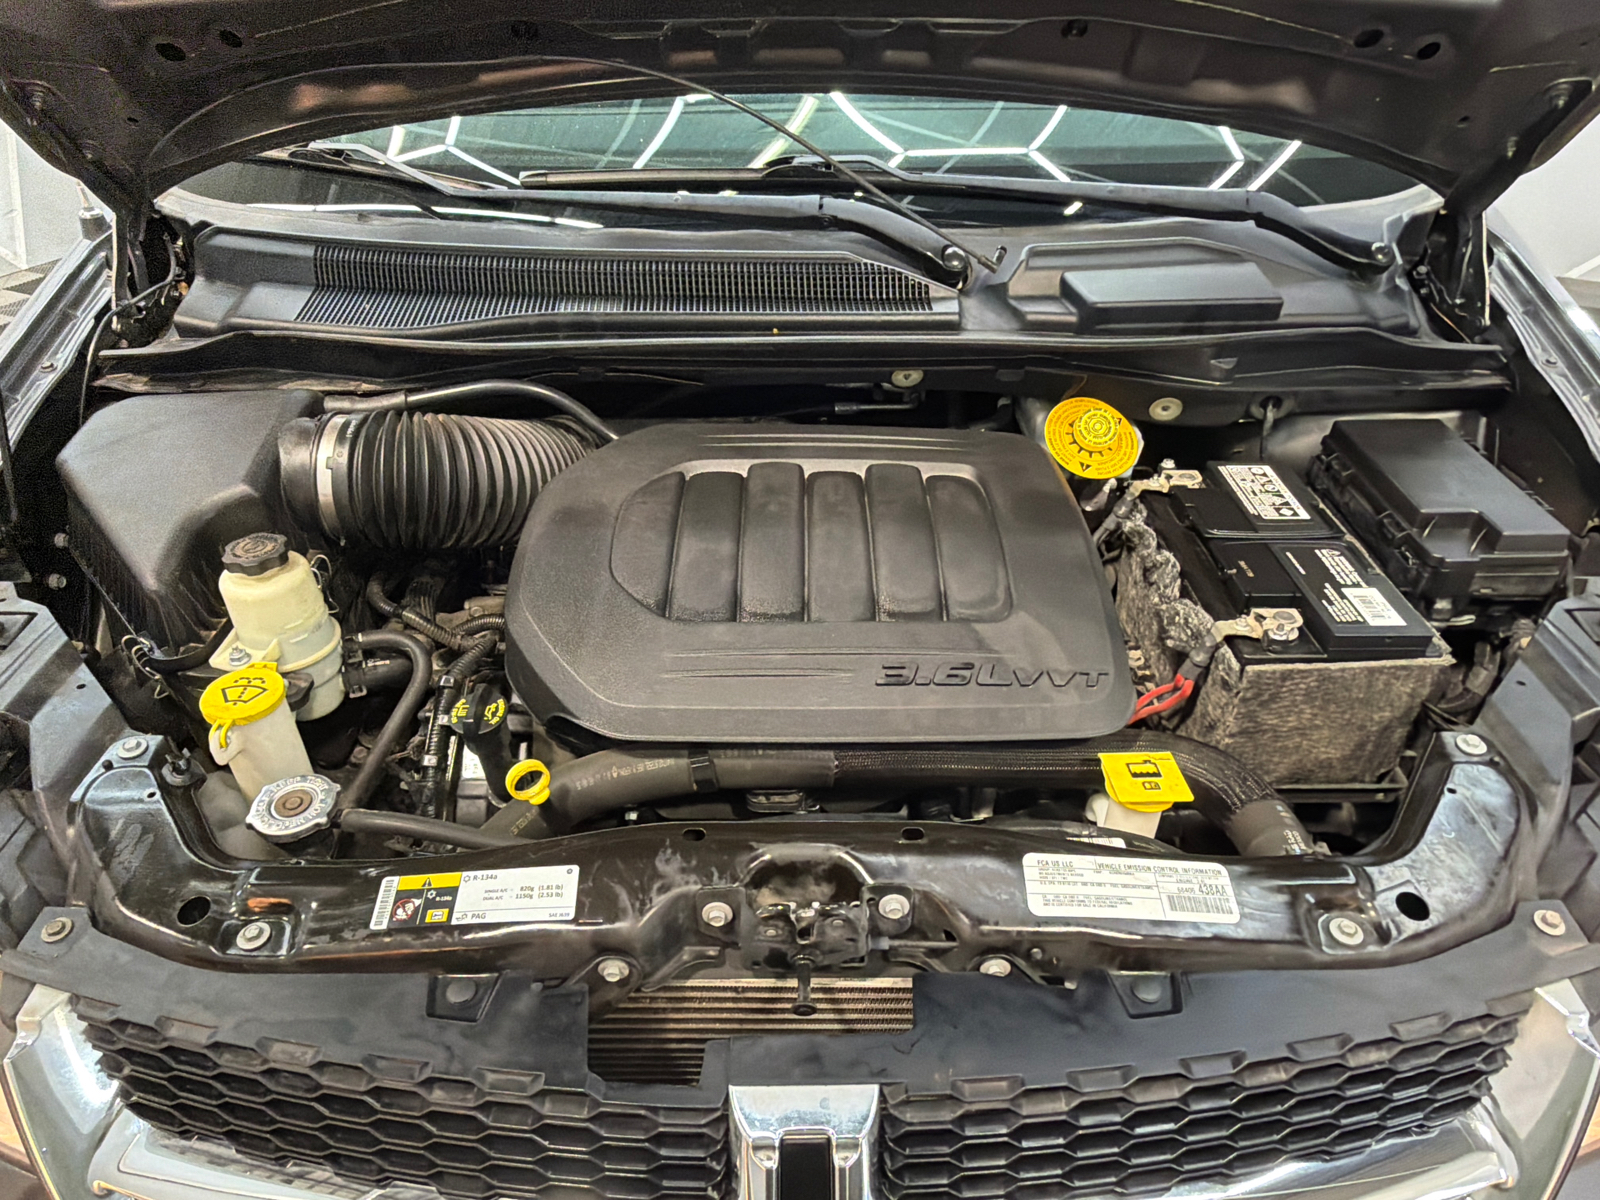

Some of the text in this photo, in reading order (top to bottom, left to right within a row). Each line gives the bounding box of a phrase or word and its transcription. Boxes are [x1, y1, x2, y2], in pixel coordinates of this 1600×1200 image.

[1096, 862, 1222, 876] VEHICLE EMISSION CONTROL INFORMATION
[472, 873, 498, 882] R-134a
[520, 885, 535, 893] 820g
[538, 884, 553, 892] (1.81
[554, 884, 564, 892] lb)
[1198, 884, 1228, 896] 438AA
[515, 892, 533, 900] 1150g
[554, 891, 564, 899] lb)
[470, 912, 487, 920] PAG
